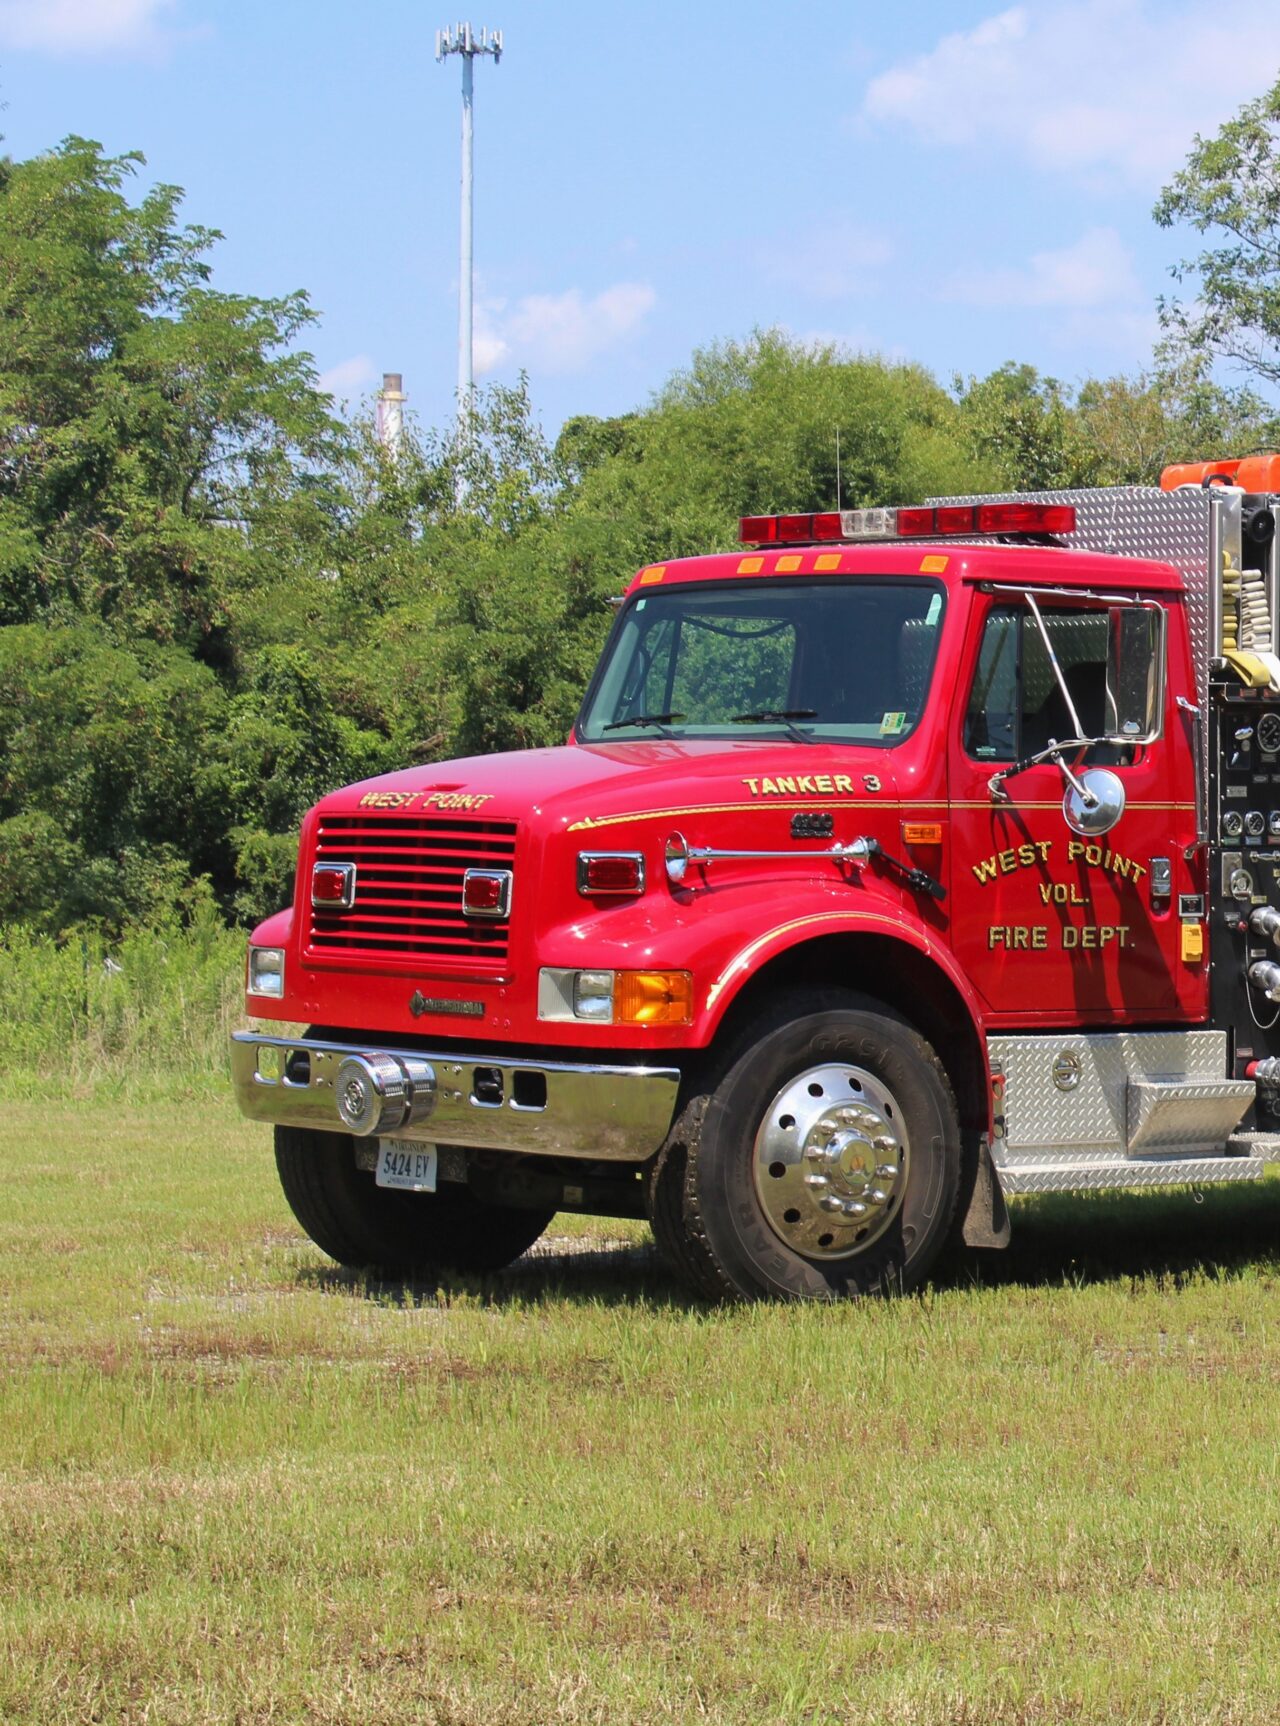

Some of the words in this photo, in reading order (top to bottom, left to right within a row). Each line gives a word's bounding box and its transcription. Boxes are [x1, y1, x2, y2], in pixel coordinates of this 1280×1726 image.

[742, 774, 854, 796] TANKER
[862, 774, 882, 792] 3
[359, 791, 424, 809] WEST
[421, 792, 495, 812] POINT
[972, 840, 1052, 885] WEST
[1068, 840, 1147, 884] POINT
[1039, 883, 1090, 905] VOL.
[988, 926, 1048, 950] FIRE
[1063, 926, 1136, 949] DEPT.
[383, 1151, 412, 1177] 5424
[415, 1154, 430, 1178] EV
